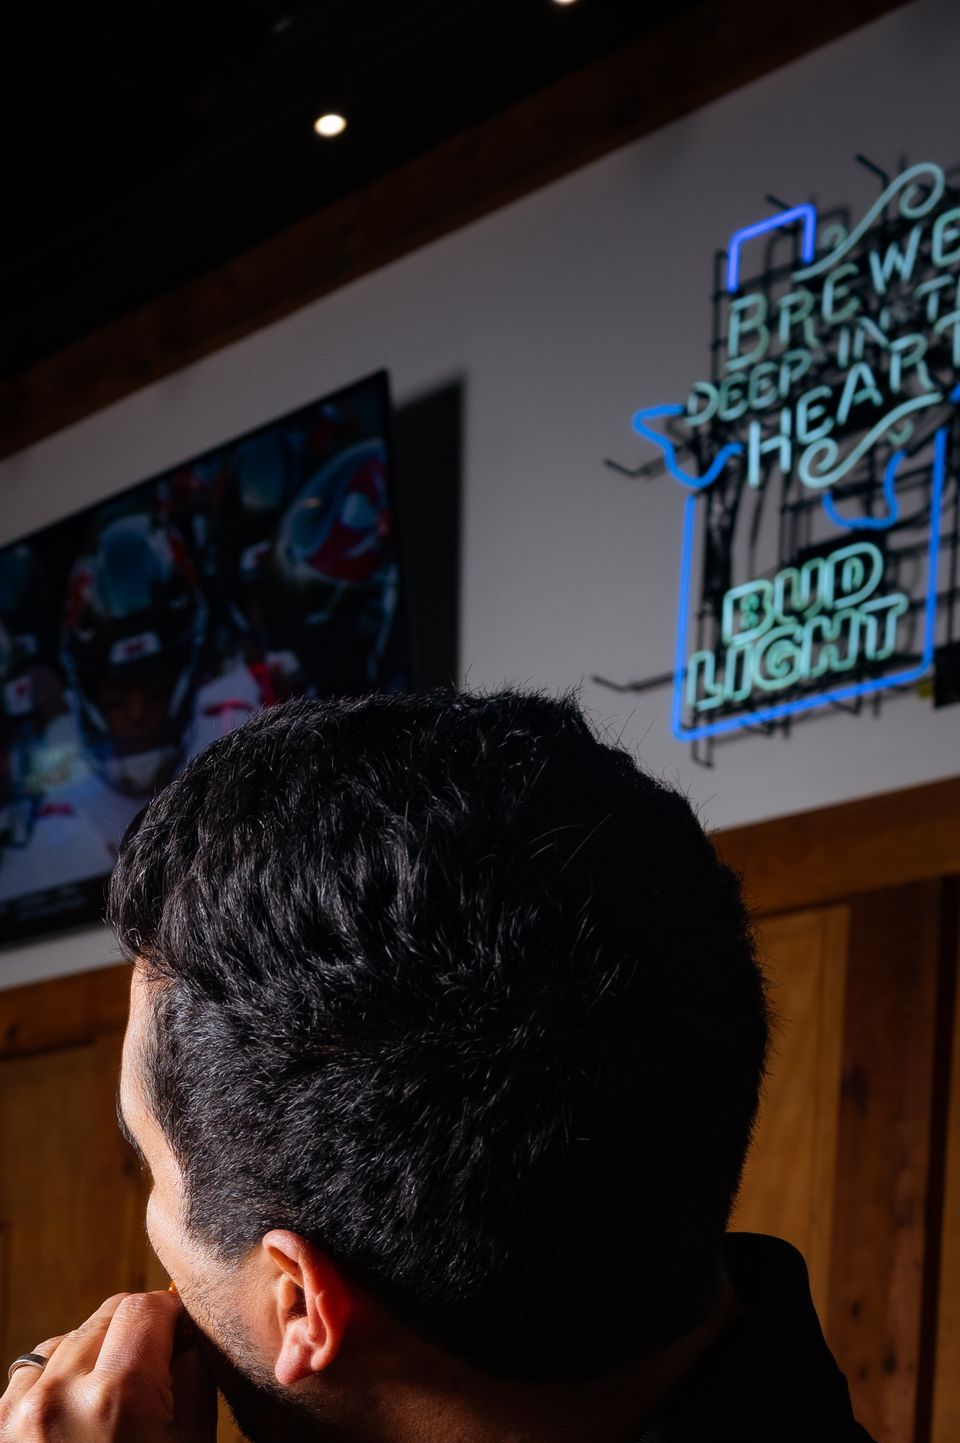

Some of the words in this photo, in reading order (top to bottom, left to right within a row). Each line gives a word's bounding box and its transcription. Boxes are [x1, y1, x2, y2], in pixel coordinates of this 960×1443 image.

[684, 349, 813, 427] DEEP
[837, 308, 891, 369] IN
[686, 593, 909, 712] LIGHT
[722, 541, 884, 647] BUD
